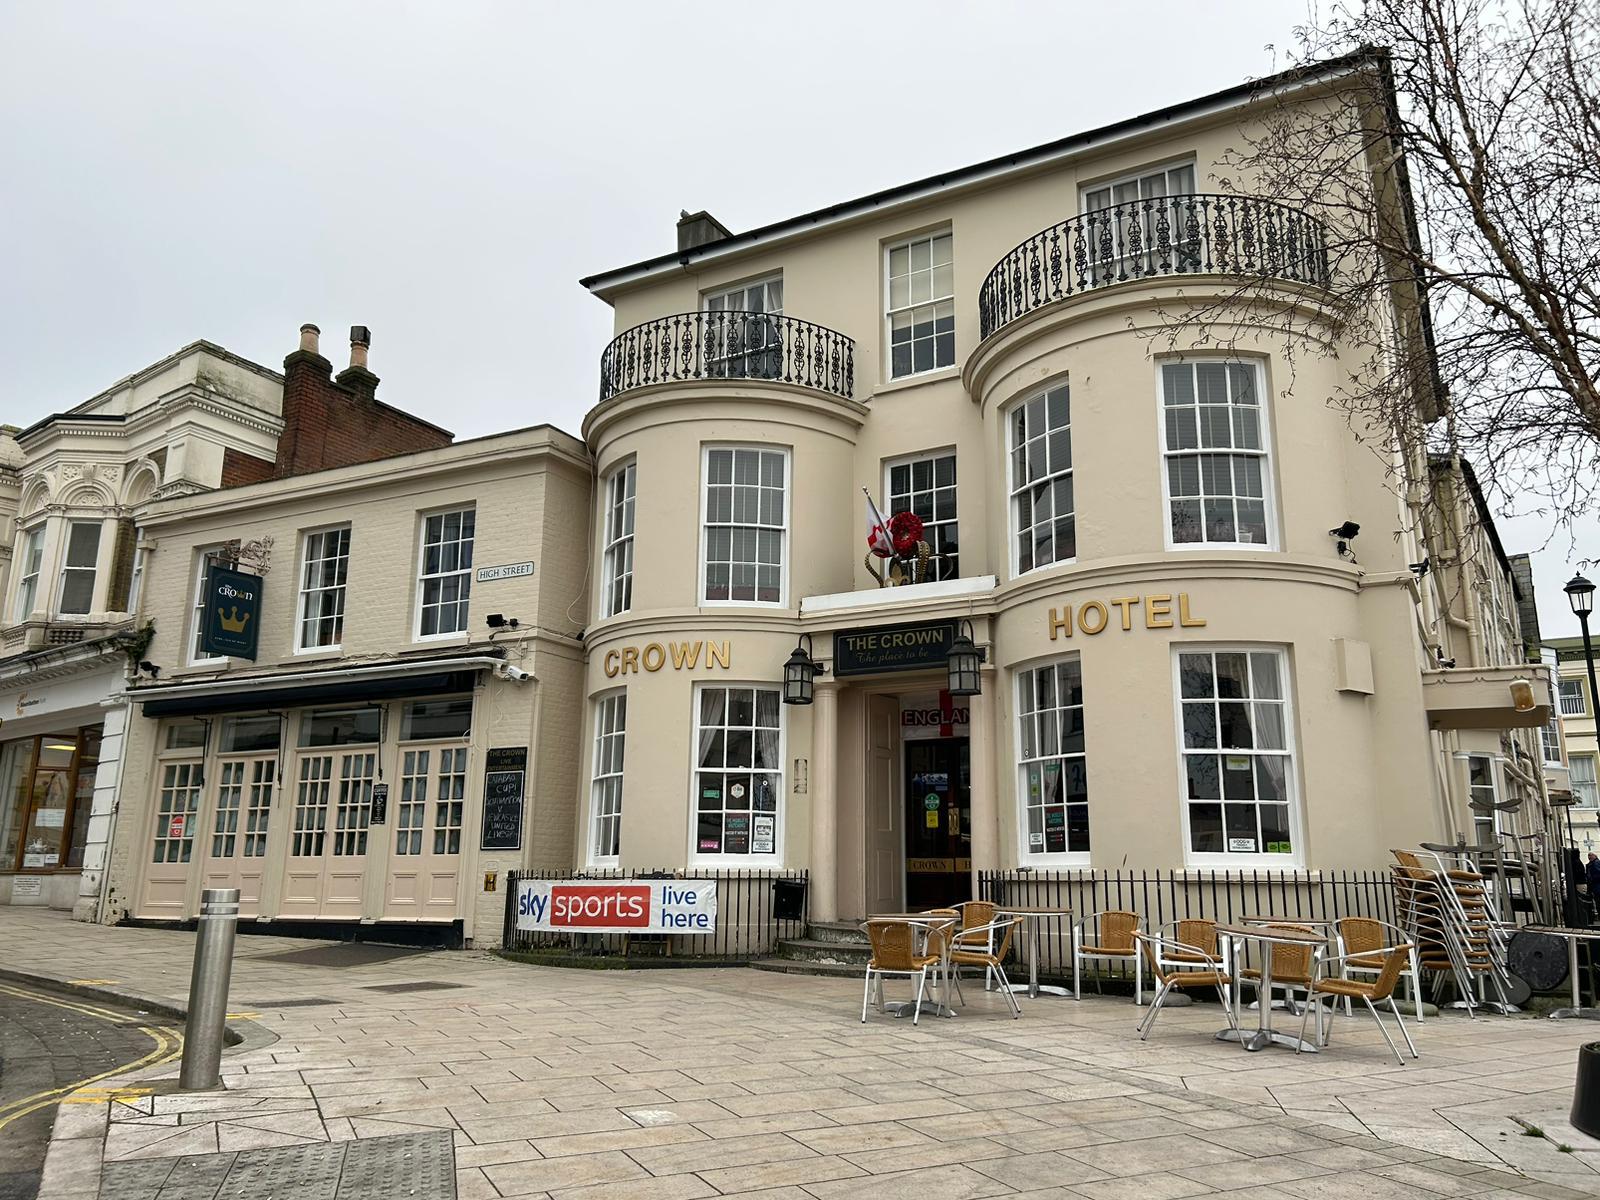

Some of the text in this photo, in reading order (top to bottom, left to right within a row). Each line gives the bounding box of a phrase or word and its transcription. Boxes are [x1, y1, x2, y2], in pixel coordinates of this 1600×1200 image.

[480, 565, 530, 579] HIGH STREET
[1048, 592, 1207, 640] HOTEL
[846, 629, 943, 651] THE CROWN
[604, 640, 731, 678] CROWN
[856, 648, 928, 664] The place to be
[902, 708, 970, 726] ENGLAN
[502, 749, 526, 757] CROWN
[912, 860, 946, 870] CROWN
[519, 886, 697, 923] sky sports live
[661, 909, 708, 927] here
